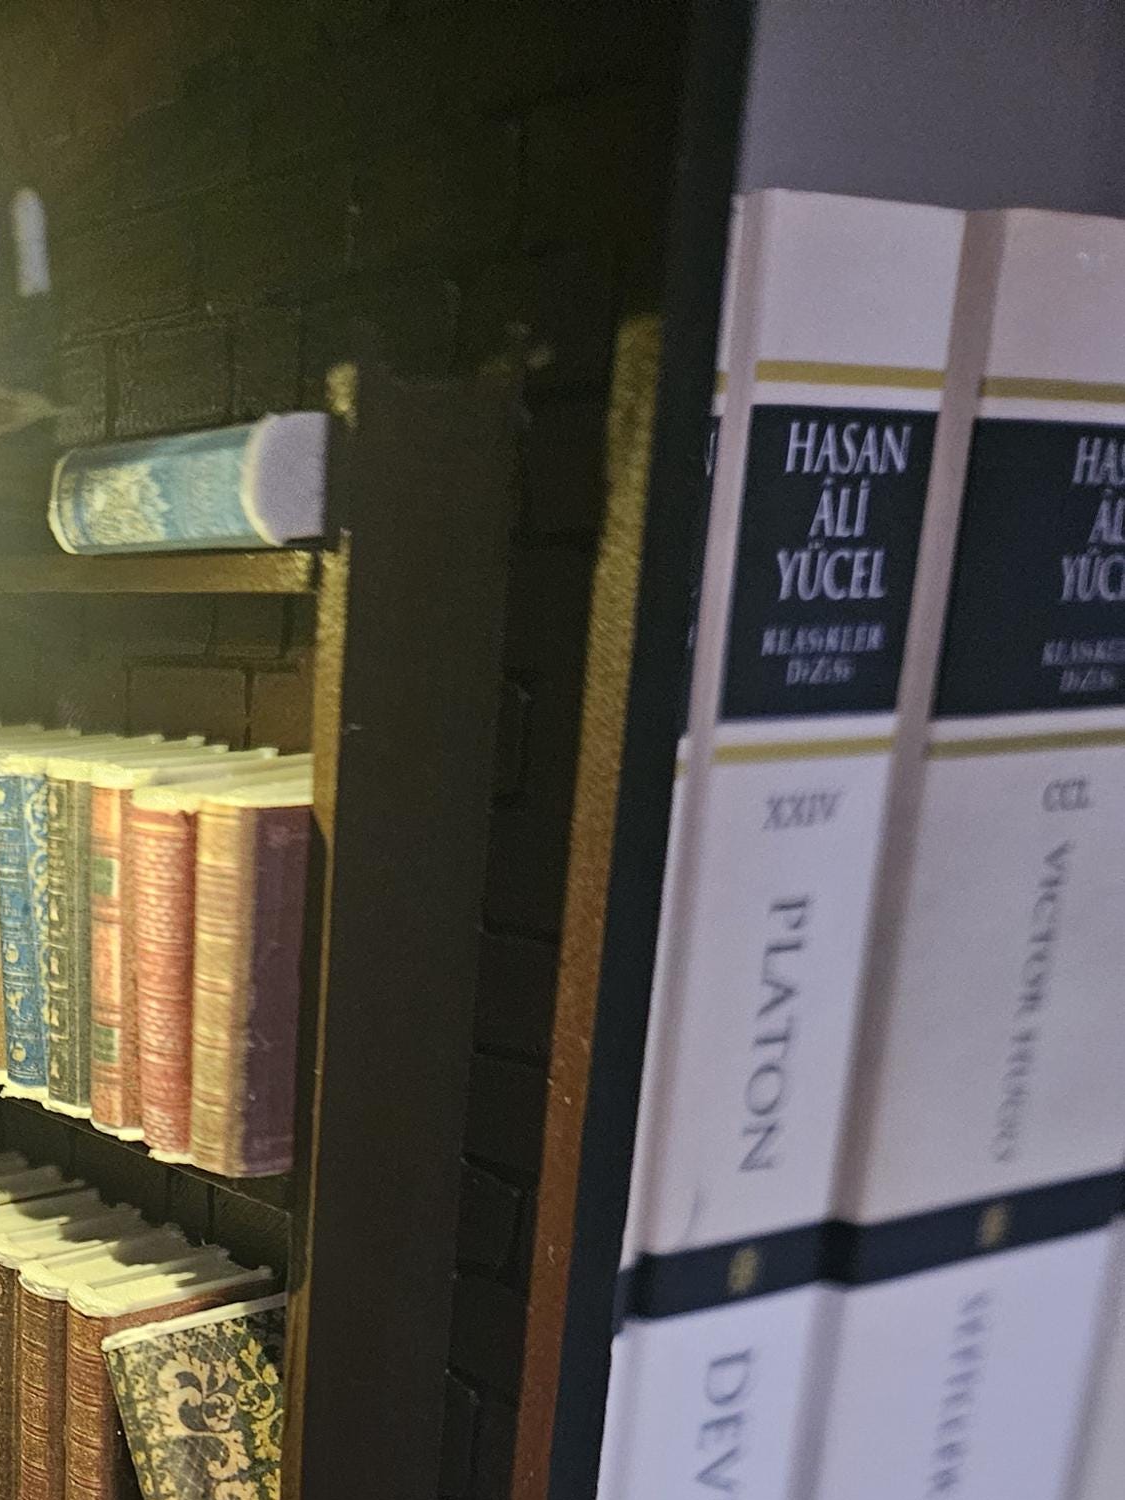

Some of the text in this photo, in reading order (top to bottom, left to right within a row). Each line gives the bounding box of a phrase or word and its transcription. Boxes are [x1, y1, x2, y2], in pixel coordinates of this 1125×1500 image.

[784, 421, 911, 476] HASAN
[808, 478, 871, 539] ÂLİ
[777, 545, 888, 600] YÜCEL
[739, 893, 813, 1175] PLATON
